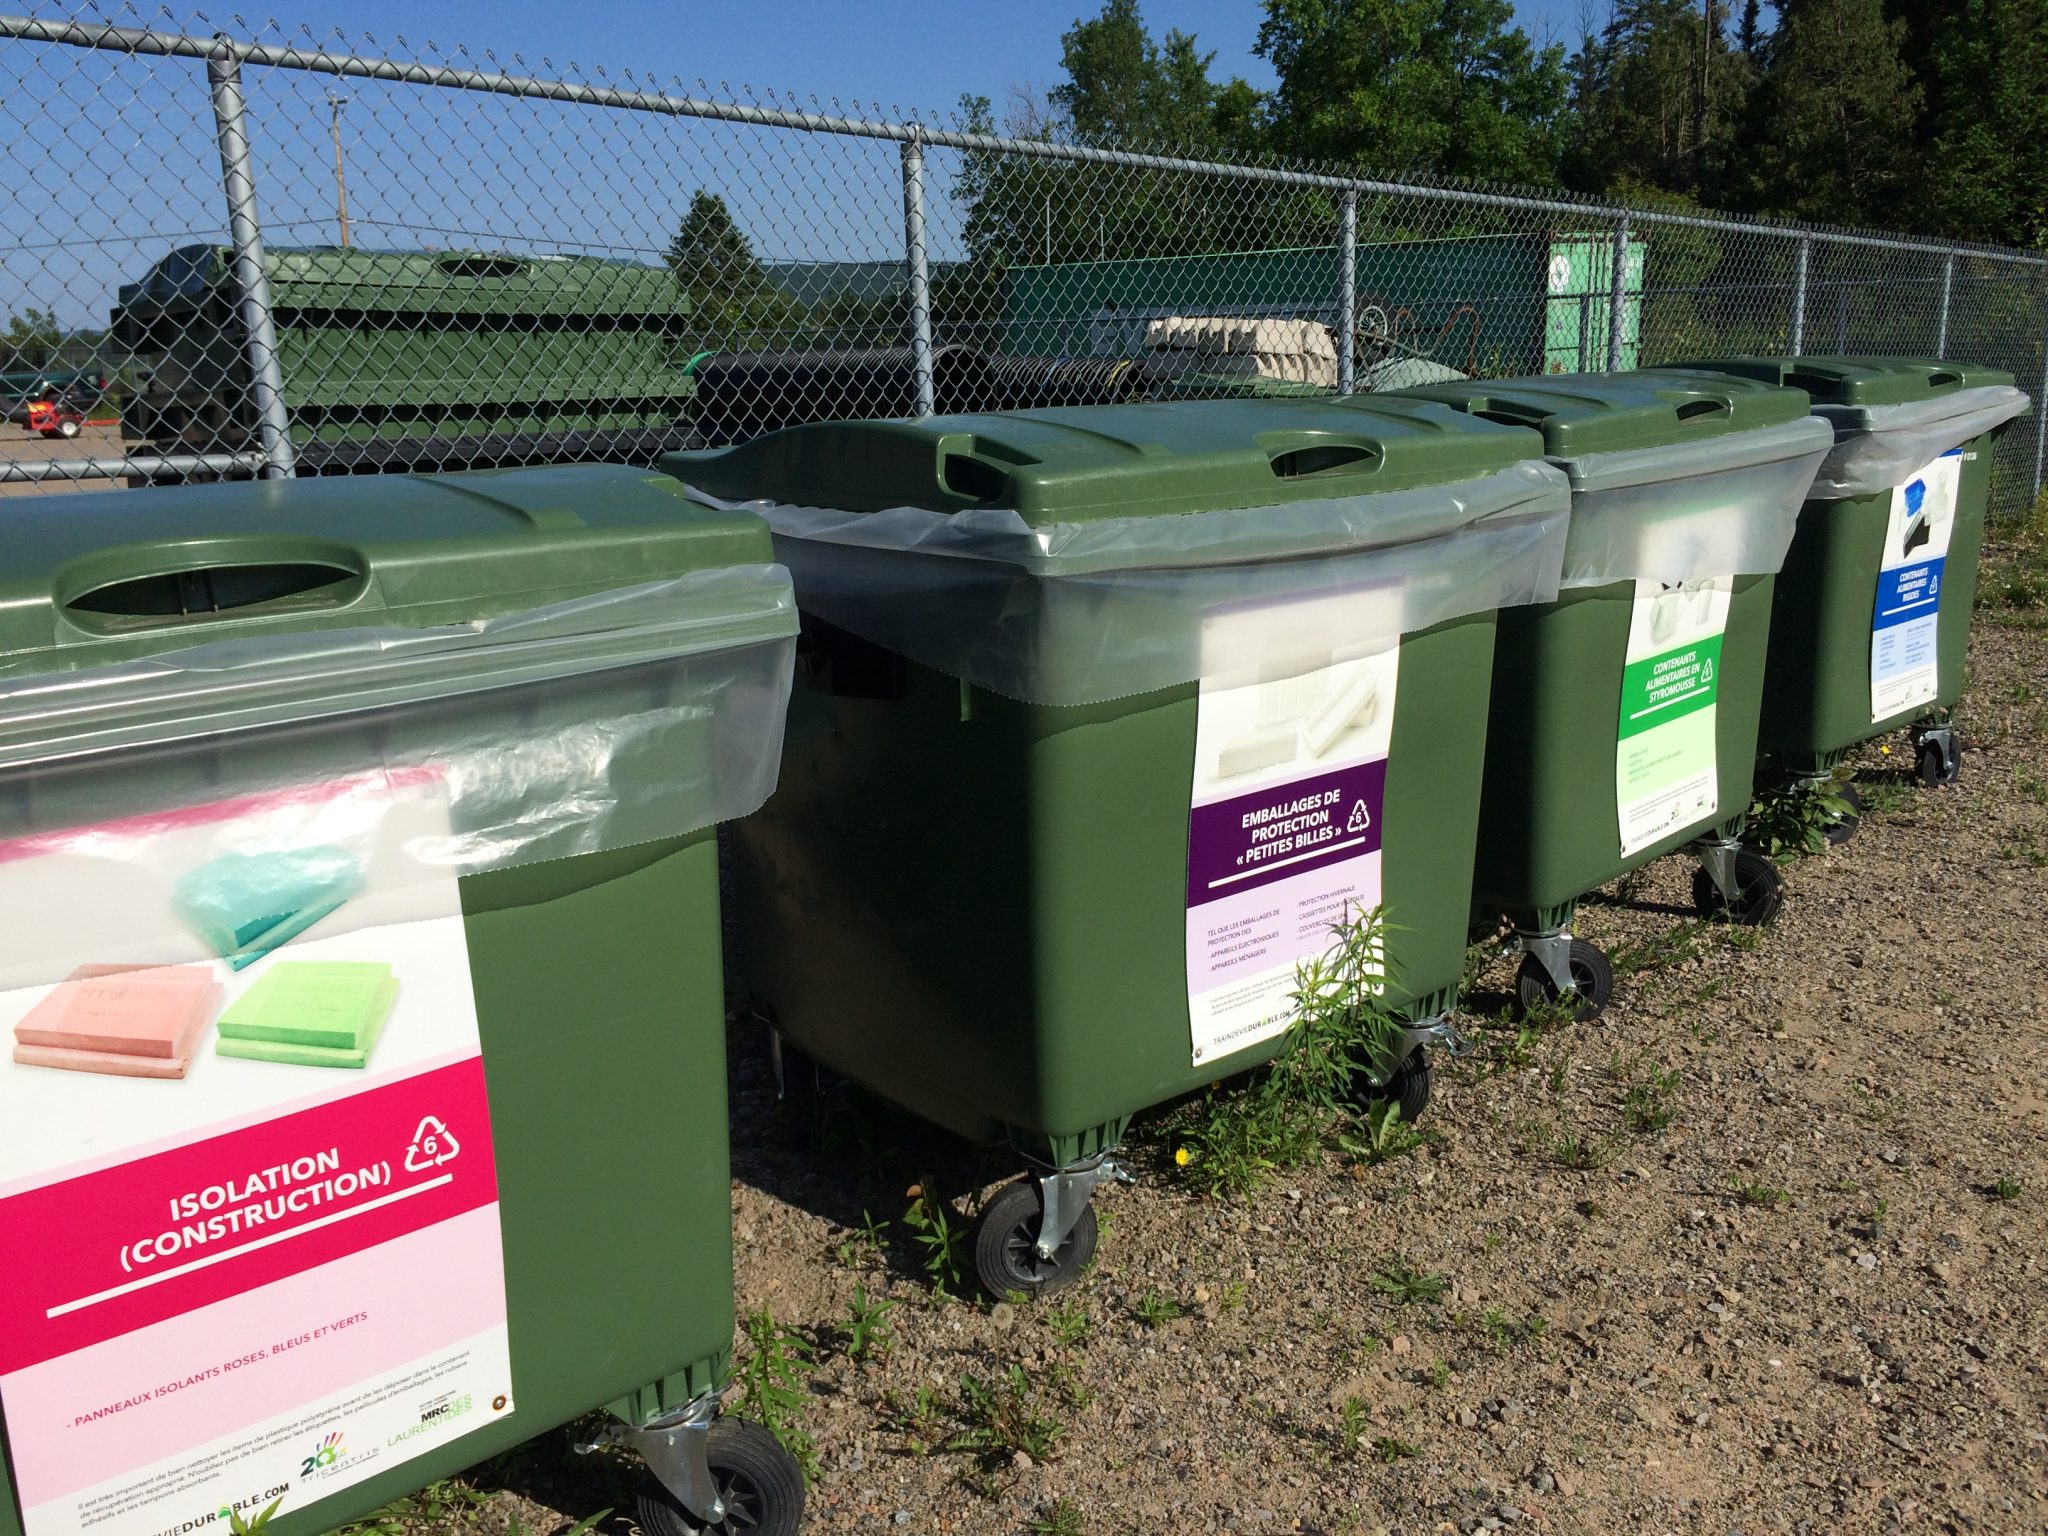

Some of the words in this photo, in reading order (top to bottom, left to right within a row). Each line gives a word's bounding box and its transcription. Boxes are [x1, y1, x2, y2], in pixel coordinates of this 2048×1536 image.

[1645, 666, 1691, 692] ALIMENTAIRES
[1691, 662, 1701, 674] EN
[1653, 651, 1697, 675] CONTENANTS
[1649, 677, 1697, 703] STYROMOUSSE
[1242, 793, 1322, 828] EMBALLAGES
[1323, 788, 1341, 806] DE
[1252, 809, 1329, 844] PROTECTION
[1246, 837, 1293, 863] PETITES
[1295, 825, 1333, 849] BILLES
[1298, 894, 1329, 908] PROTECTION
[1329, 885, 1355, 898] HIVERNALE
[1208, 929, 1217, 937] TEL
[1217, 925, 1229, 934] QUE
[1229, 921, 1239, 930] LES
[1239, 911, 1273, 927] EMBALLAGES
[1272, 908, 1280, 916] DE
[1298, 907, 1327, 920] CAISSETTES
[1208, 931, 1241, 947] PROTECTION
[1241, 927, 1252, 936] DES
[1211, 944, 1238, 958] APPAREILS
[1211, 957, 1238, 972] APPAREILS
[423, 1135, 438, 1155] 6
[169, 1147, 340, 1221] ISOLATION
[120, 1160, 391, 1272] (CONSTRUCTION)
[74, 1392, 152, 1426] PANNEAUX
[154, 1367, 220, 1398] ISOLANTS
[223, 1350, 269, 1372] ROSES,
[272, 1333, 311, 1355] BLEUS
[313, 1326, 328, 1339] ET
[331, 1311, 368, 1332] VERTS
[420, 1404, 450, 1423] MRC
[448, 1393, 473, 1408] DES
[80, 1511, 91, 1519] de
[93, 1491, 144, 1516] récupération
[187, 1461, 225, 1478] N'oubliez
[225, 1455, 239, 1466] pas
[240, 1450, 251, 1459] de
[252, 1443, 269, 1454] bien
[270, 1434, 293, 1446] retirer
[293, 1428, 304, 1437] les
[343, 1407, 353, 1416] les
[354, 1394, 387, 1414] pellicules
[434, 1369, 445, 1378] les
[445, 1360, 468, 1373] rubans
[85, 1499, 97, 1508] est
[115, 1477, 154, 1498] important
[156, 1472, 167, 1481] de
[168, 1466, 186, 1477] bien
[187, 1453, 219, 1470] nettoyer
[220, 1447, 231, 1456] les
[232, 1440, 253, 1452] items
[254, 1434, 265, 1443] de
[265, 1421, 299, 1441] plastique
[300, 1403, 341, 1427] polystyrène
[342, 1395, 362, 1408] avant
[362, 1390, 372, 1400] de
[373, 1386, 383, 1395] les
[384, 1374, 412, 1392] déposer
[412, 1367, 430, 1379] dans
[437, 1350, 470, 1368] contenant
[387, 1402, 473, 1447] LAURENTIDES
[81, 1510, 115, 1528] adhésifs
[116, 1505, 126, 1515] et
[126, 1502, 139, 1512] les
[139, 1489, 175, 1508] tampons
[176, 1471, 221, 1493] absorbants.
